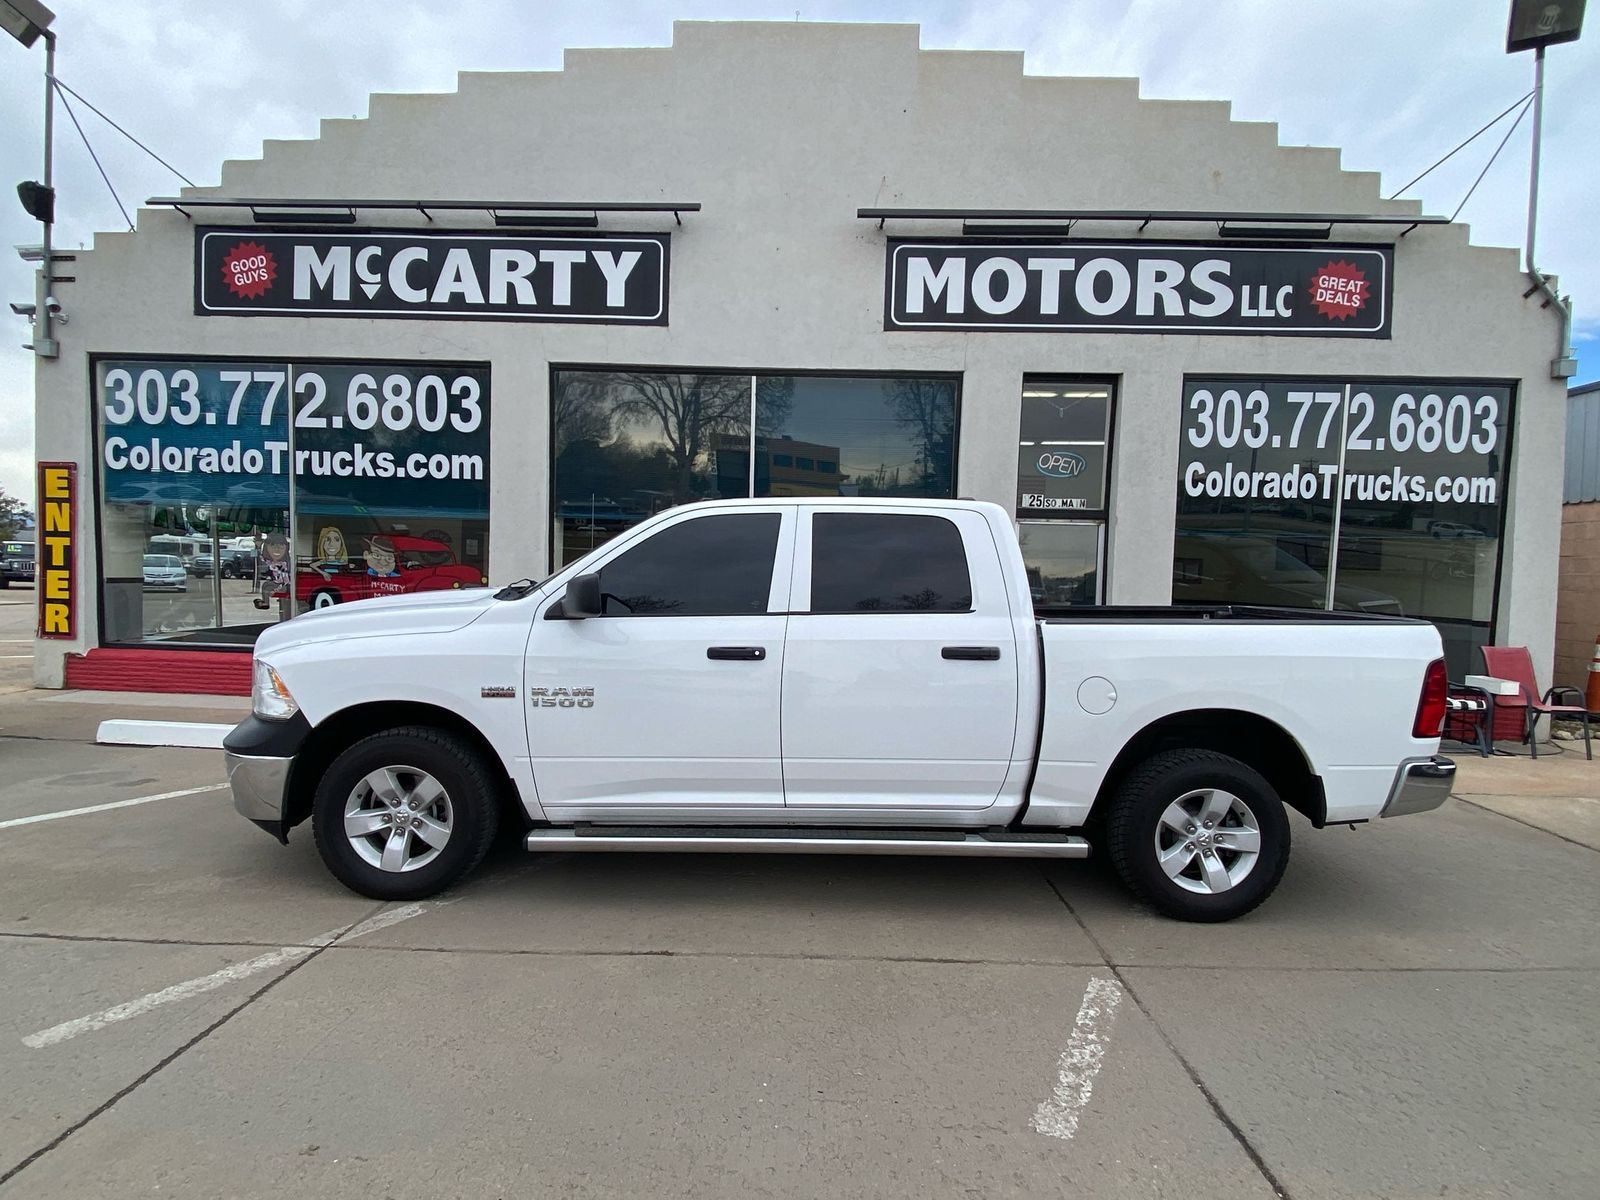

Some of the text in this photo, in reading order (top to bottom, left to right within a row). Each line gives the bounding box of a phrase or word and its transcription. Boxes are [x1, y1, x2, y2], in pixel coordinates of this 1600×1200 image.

[231, 255, 267, 273] GOOD
[234, 269, 268, 286] GUYS
[906, 256, 1293, 318] MOTORS LLC
[1319, 275, 1364, 294] GREAT
[1316, 289, 1360, 307] DEALS
[104, 368, 482, 433] 303.772.6803
[1188, 389, 1498, 454] 303.772.6803
[104, 436, 483, 480] ColoradoTrucks.com
[1038, 453, 1083, 476] OPEN
[1184, 461, 1496, 504] ColoradoTrucks.com
[45, 468, 71, 633] ENTER
[531, 686, 595, 697] RAM
[531, 697, 595, 708] 1500
